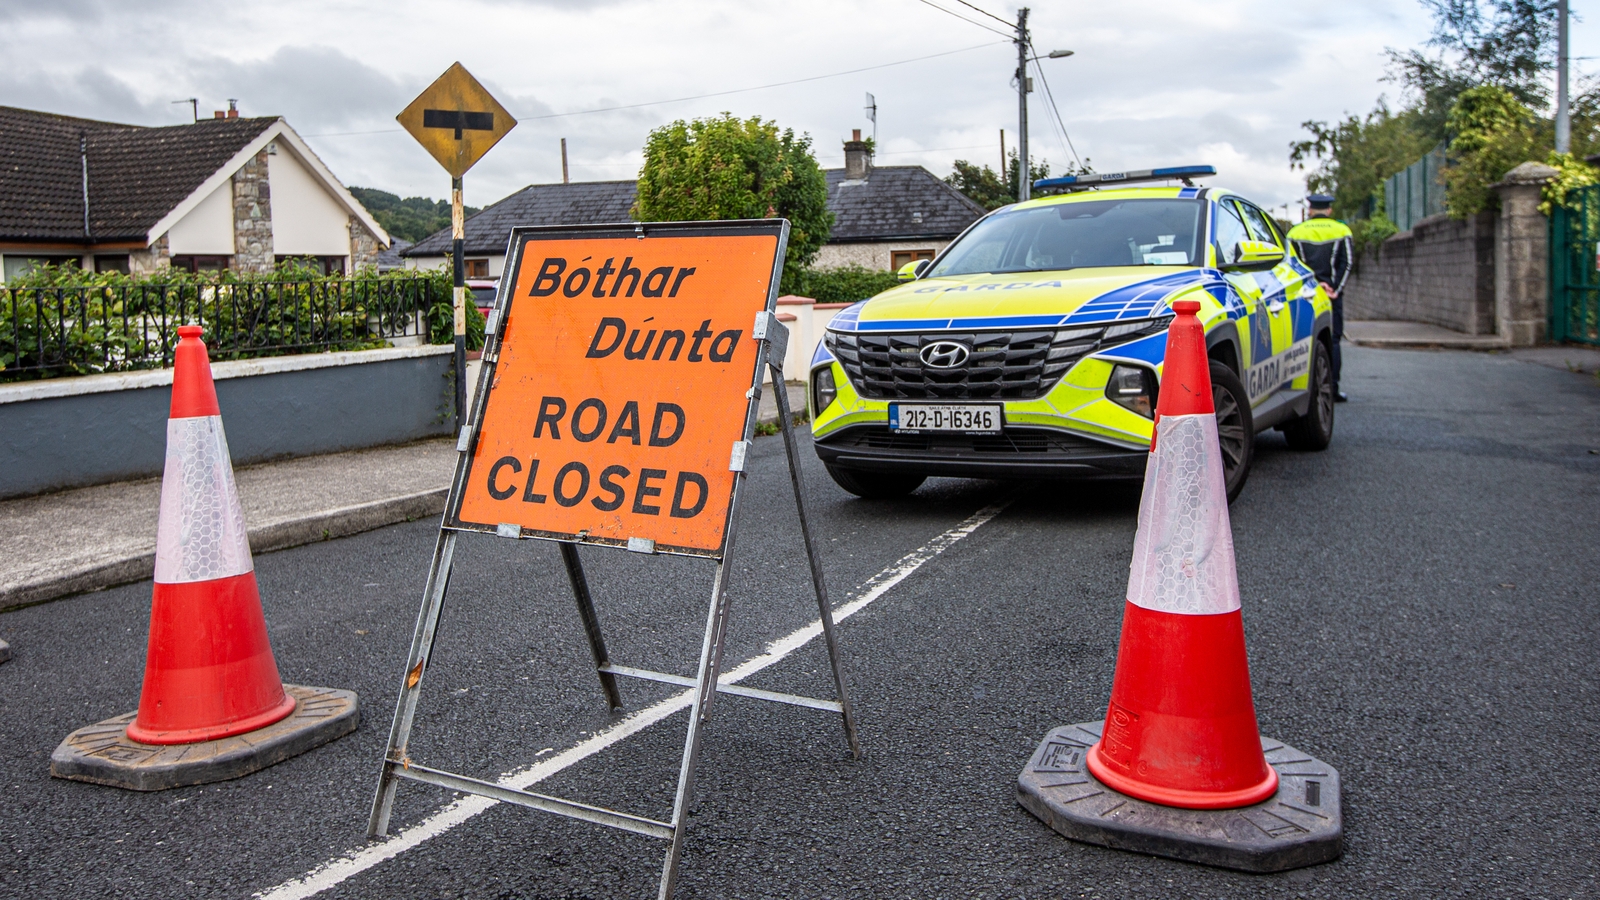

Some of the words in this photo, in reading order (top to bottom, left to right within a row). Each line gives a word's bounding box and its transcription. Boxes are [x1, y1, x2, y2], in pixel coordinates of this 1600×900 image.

[528, 256, 697, 299] Bóthar
[914, 280, 1062, 294] GARDA
[585, 316, 743, 363] Dúnta
[1249, 358, 1280, 399] GARDA
[532, 396, 686, 448] ROAD
[905, 410, 993, 429] 212-D-16346
[487, 455, 709, 519] CLOSED
